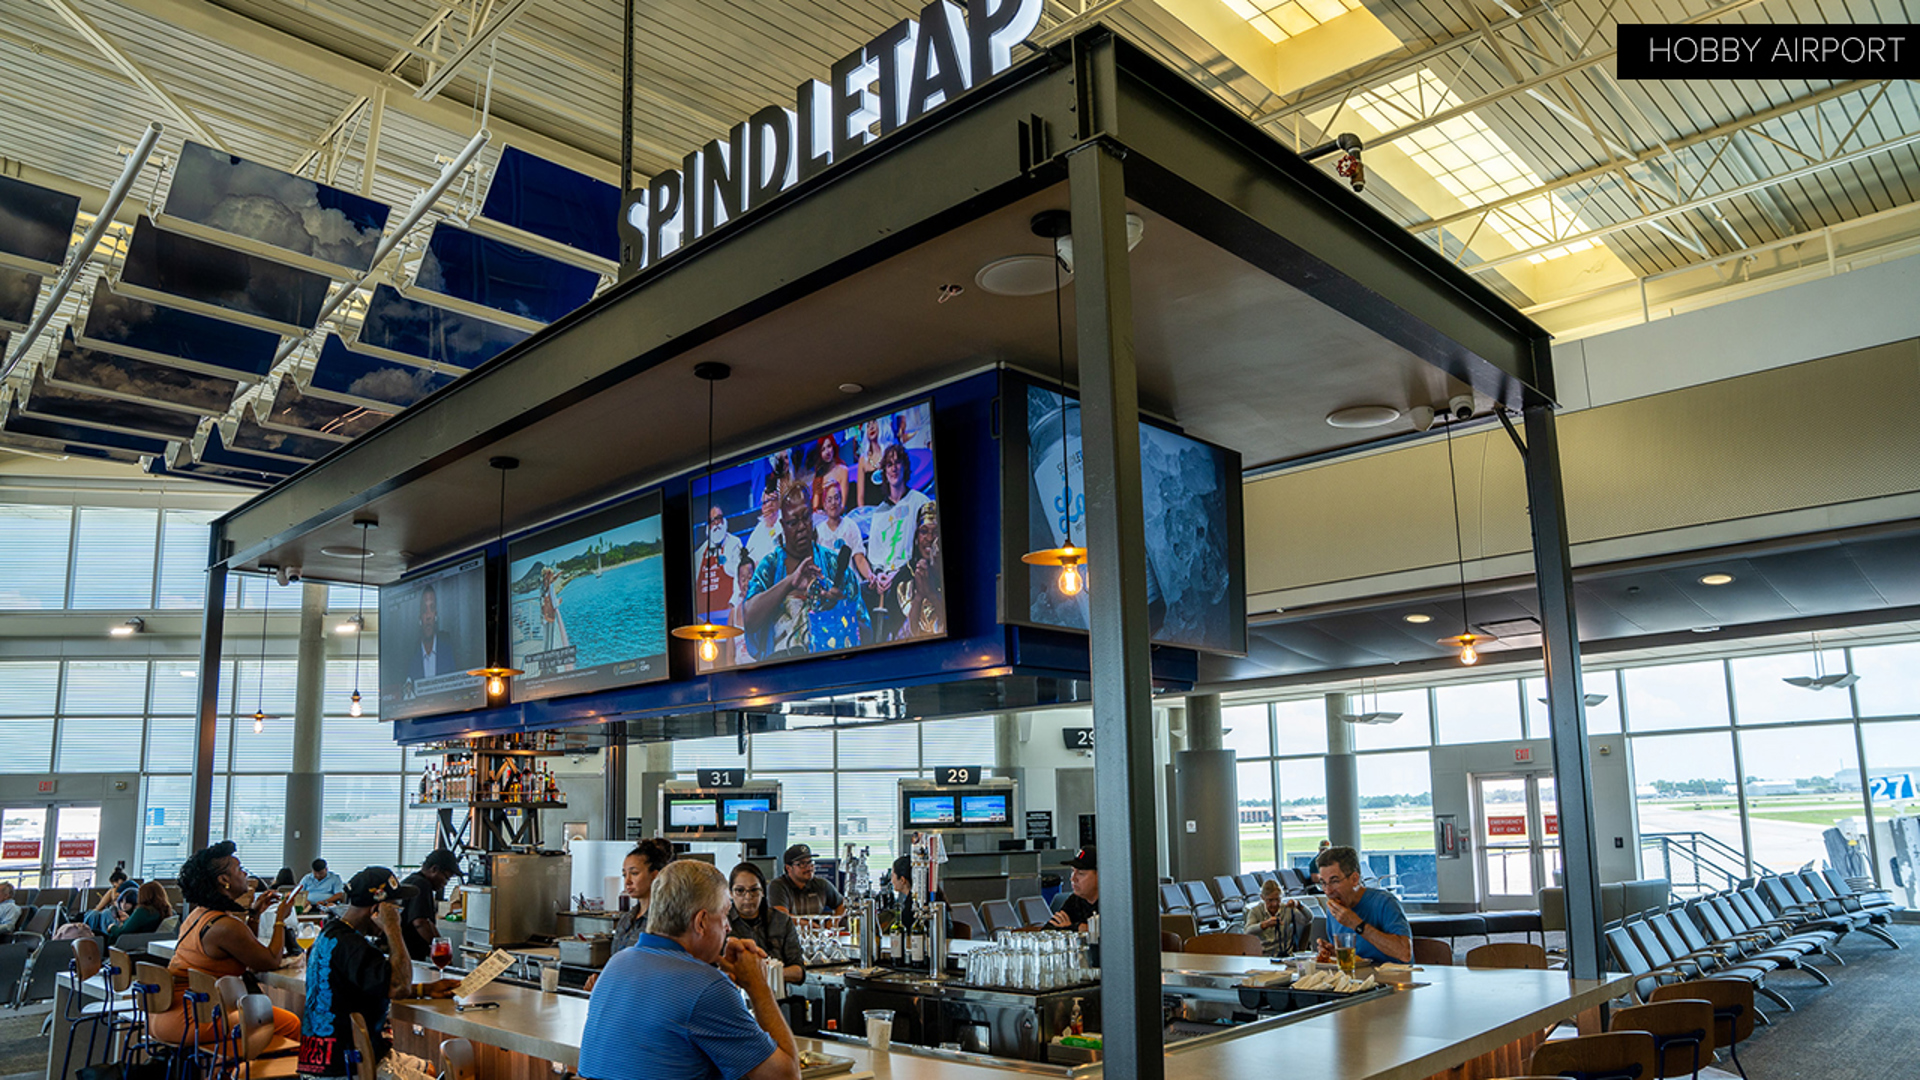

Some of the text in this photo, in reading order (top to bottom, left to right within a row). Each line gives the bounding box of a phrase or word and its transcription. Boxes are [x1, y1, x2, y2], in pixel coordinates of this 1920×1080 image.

[617, 0, 1045, 276] SPINDLETAP
[1515, 748, 1529, 760] EXIT
[711, 771, 732, 786] 31
[948, 768, 969, 783] 29
[39, 781, 53, 792] EXIT
[1870, 776, 1906, 800] 27
